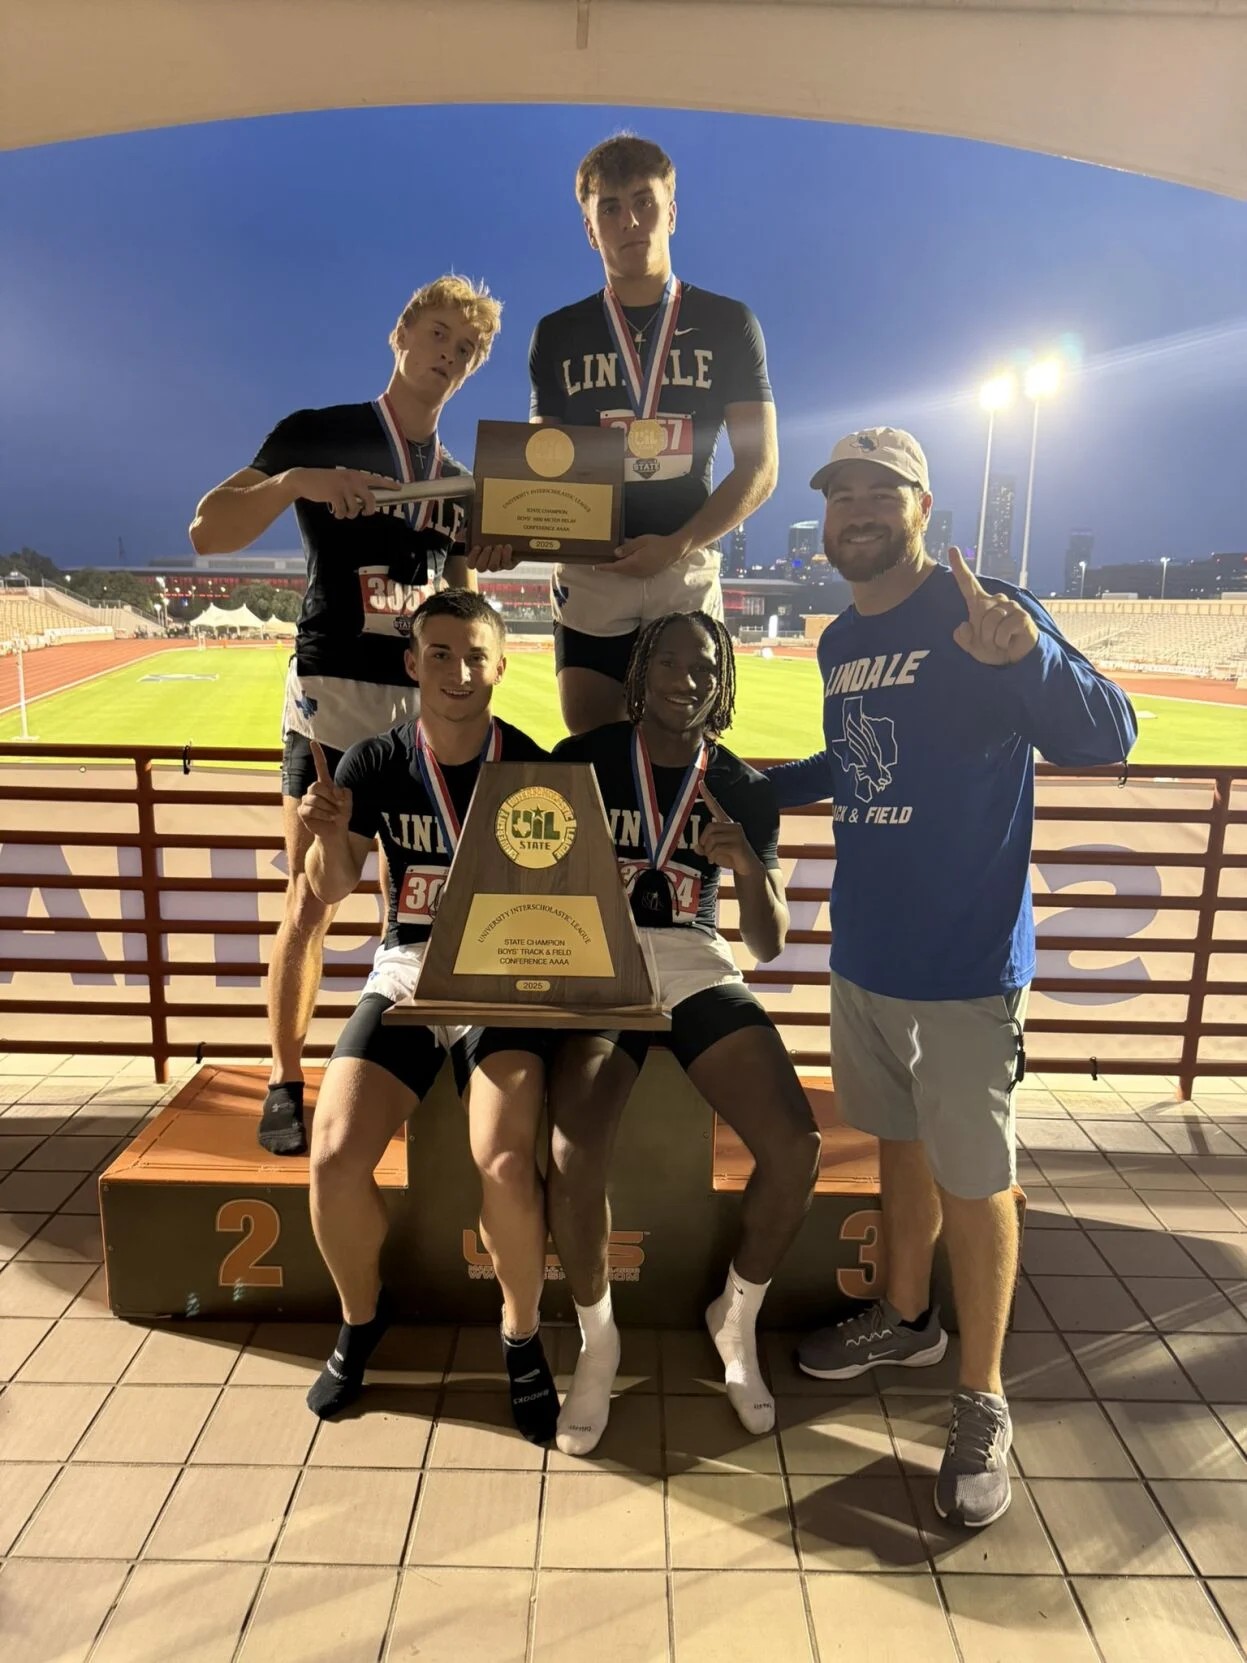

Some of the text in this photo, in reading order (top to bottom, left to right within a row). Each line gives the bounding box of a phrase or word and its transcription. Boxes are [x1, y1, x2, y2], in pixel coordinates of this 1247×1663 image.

[563, 350, 713, 396] LINLE
[825, 650, 931, 697] LINDALE
[848, 807, 859, 824] &
[865, 806, 913, 824] FIELD
[519, 841, 552, 850] STATE
[478, 903, 592, 944] UNIVERSITY INTERSCHOLASTIC LEAGUE
[504, 938, 525, 946] STATE
[500, 957, 548, 965] CONFERENCE
[523, 982, 543, 990] 2025
[216, 1199, 283, 1287] 2
[837, 1209, 883, 1300] 3
